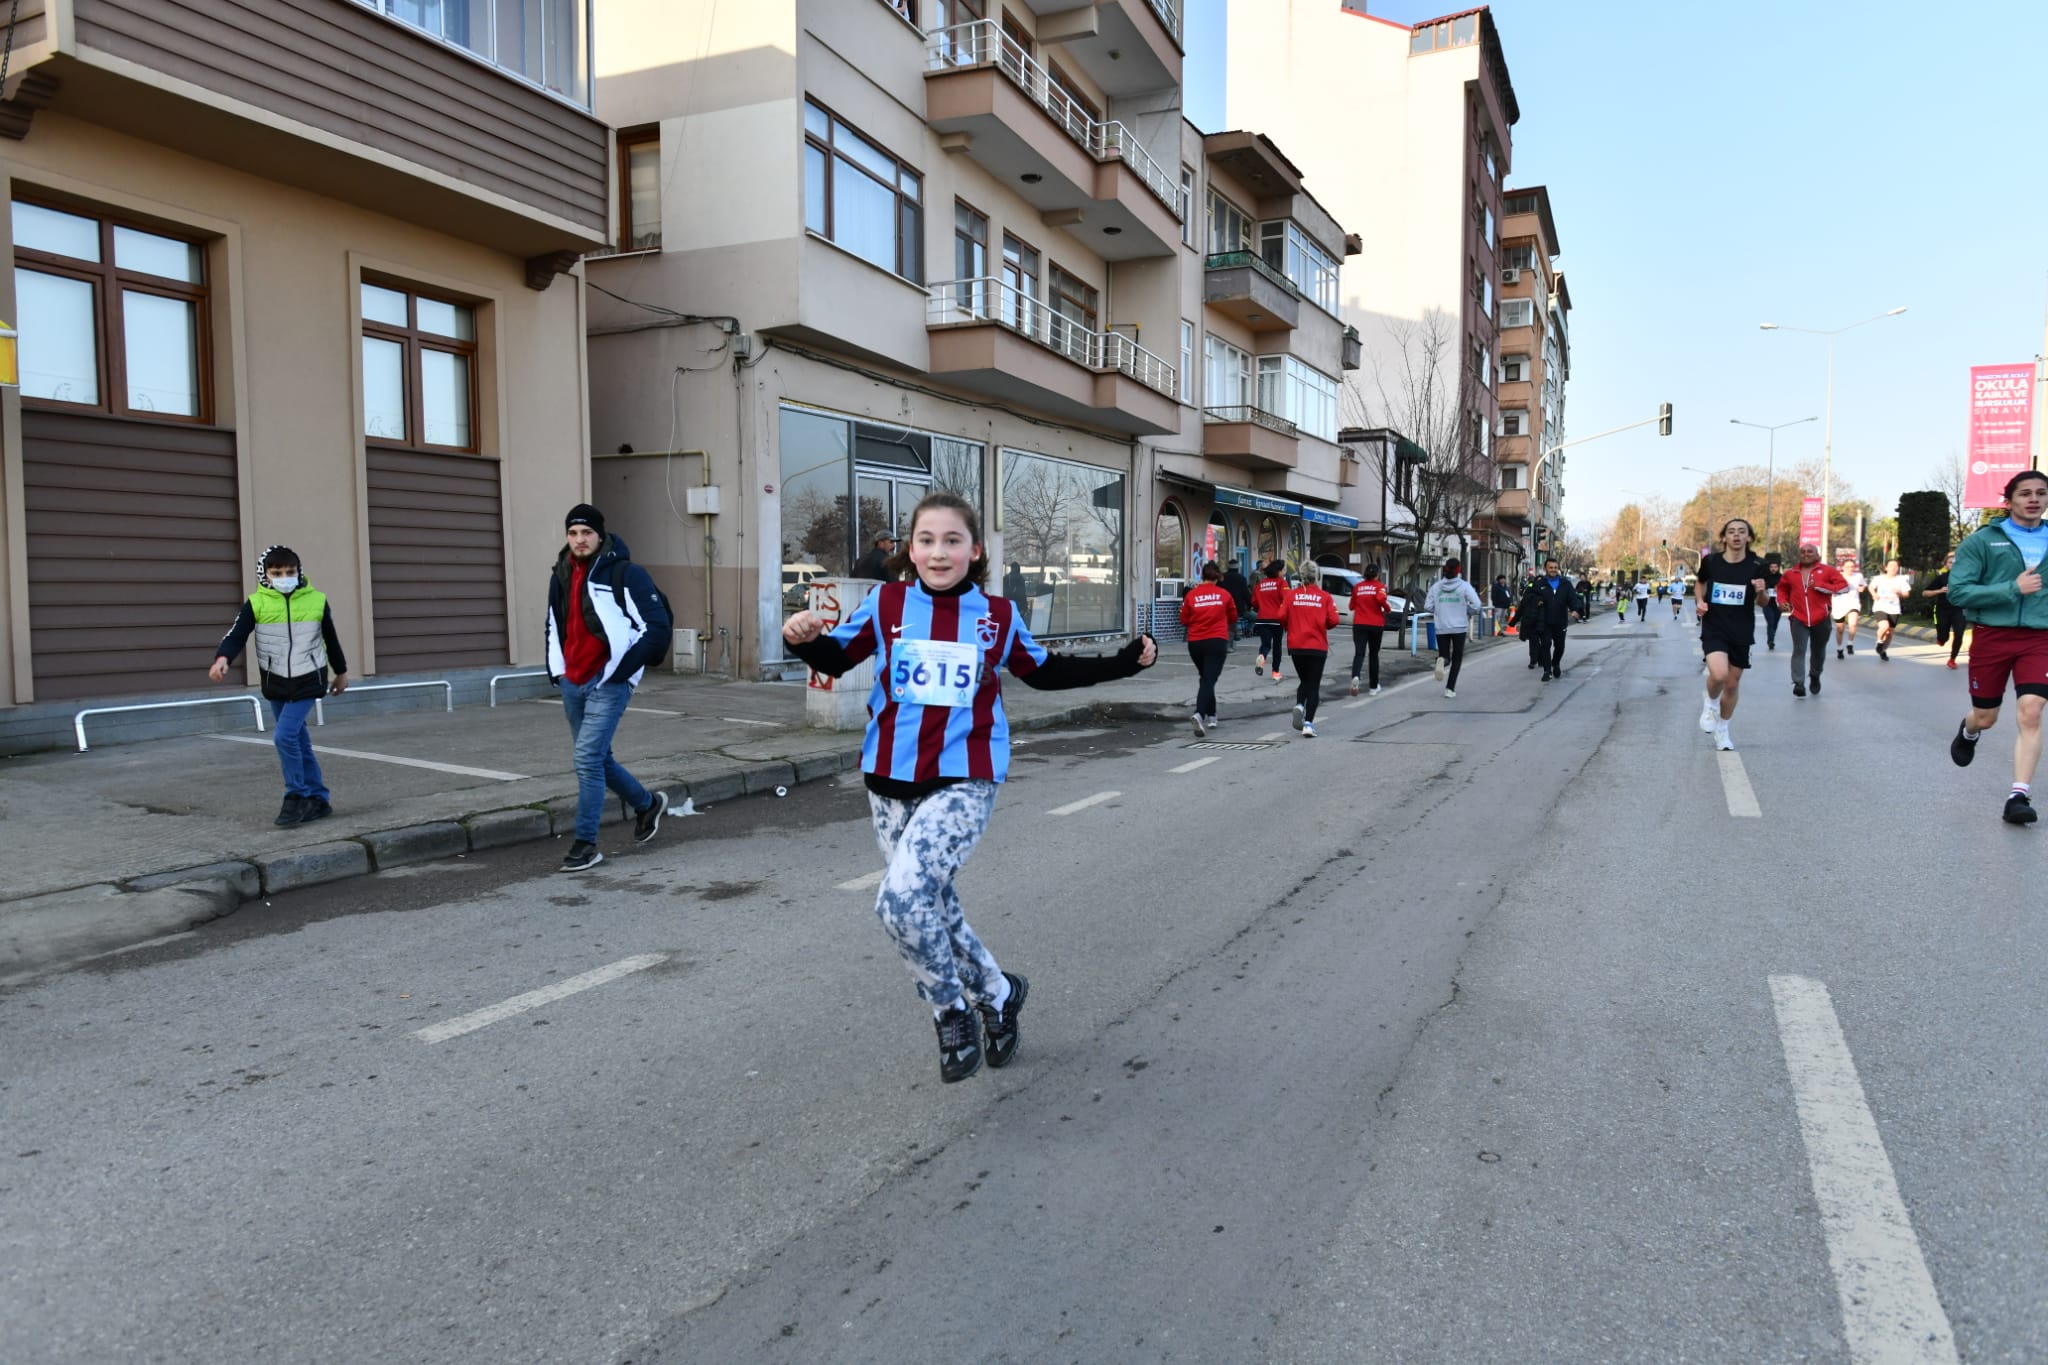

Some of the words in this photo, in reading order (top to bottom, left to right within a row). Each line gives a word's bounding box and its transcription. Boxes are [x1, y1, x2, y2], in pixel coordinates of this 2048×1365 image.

[1975, 379, 2029, 391] OKULA
[1974, 406, 2028, 415] SINAVI
[1713, 590, 1743, 599] 5148
[895, 660, 971, 689] 5615
